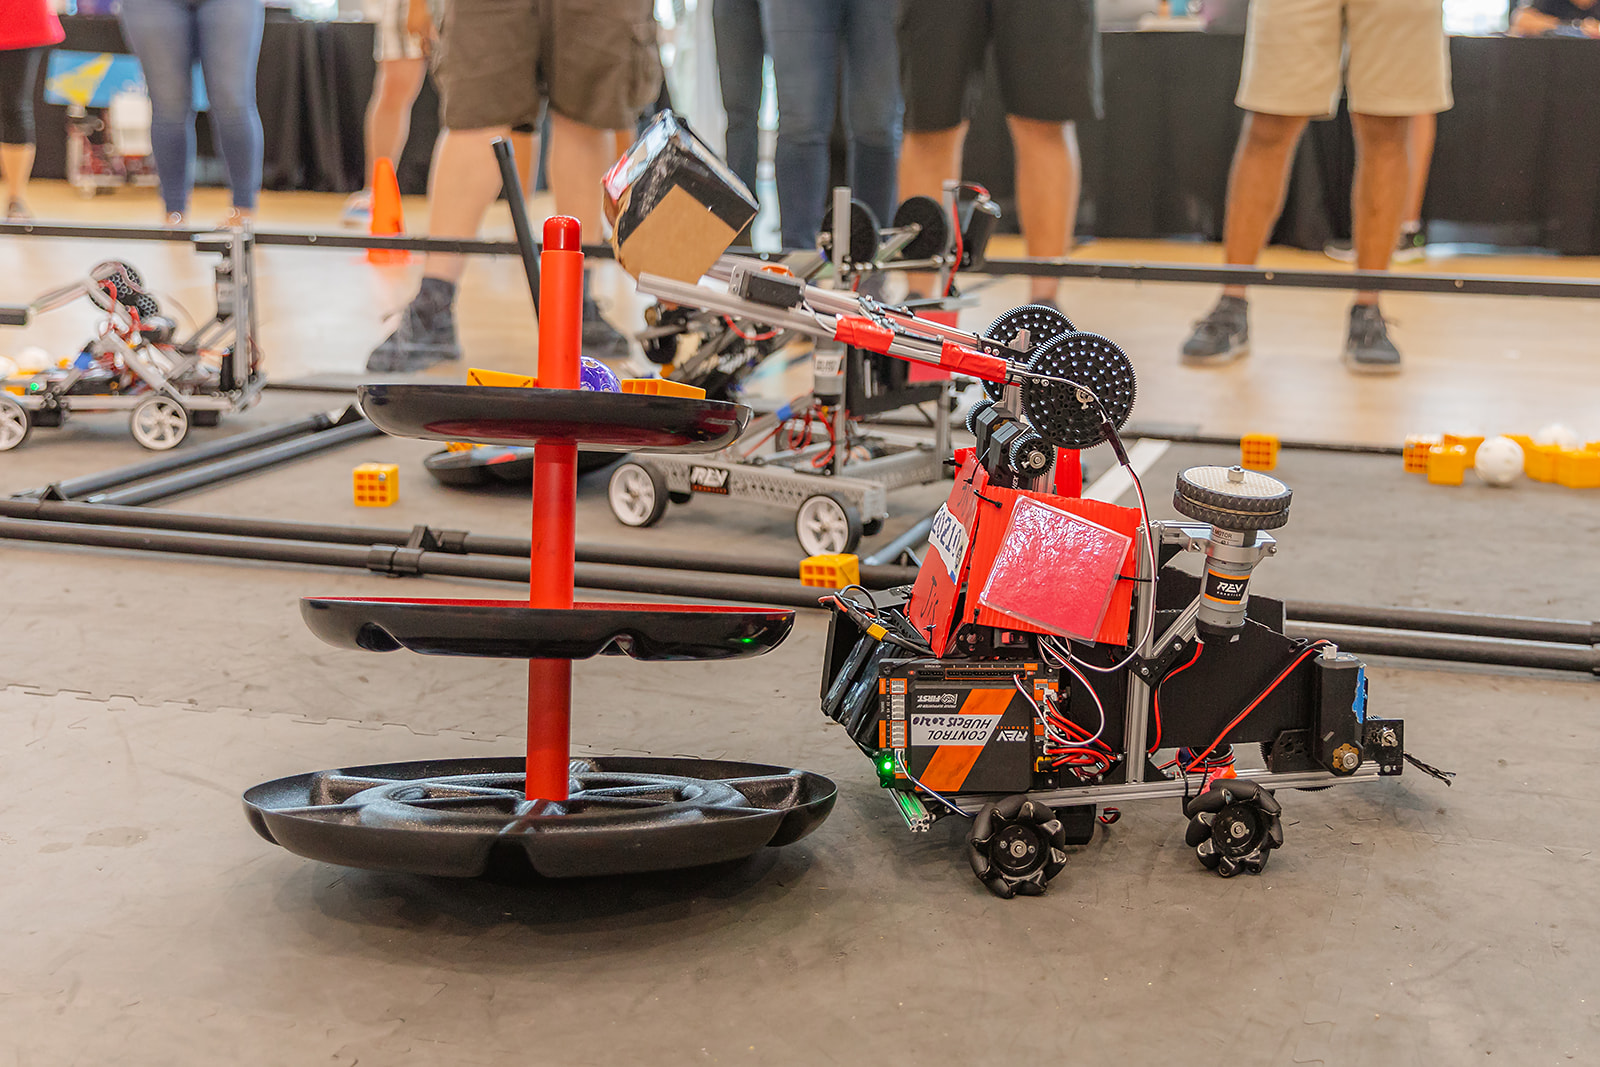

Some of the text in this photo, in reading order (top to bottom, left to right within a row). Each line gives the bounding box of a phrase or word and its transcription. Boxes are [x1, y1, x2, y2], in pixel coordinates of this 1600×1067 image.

[691, 466, 728, 487] REV
[1216, 581, 1244, 593] REV
[963, 719, 992, 729] HUB
[928, 730, 987, 741] CONTROL
[996, 730, 1029, 742] REV
